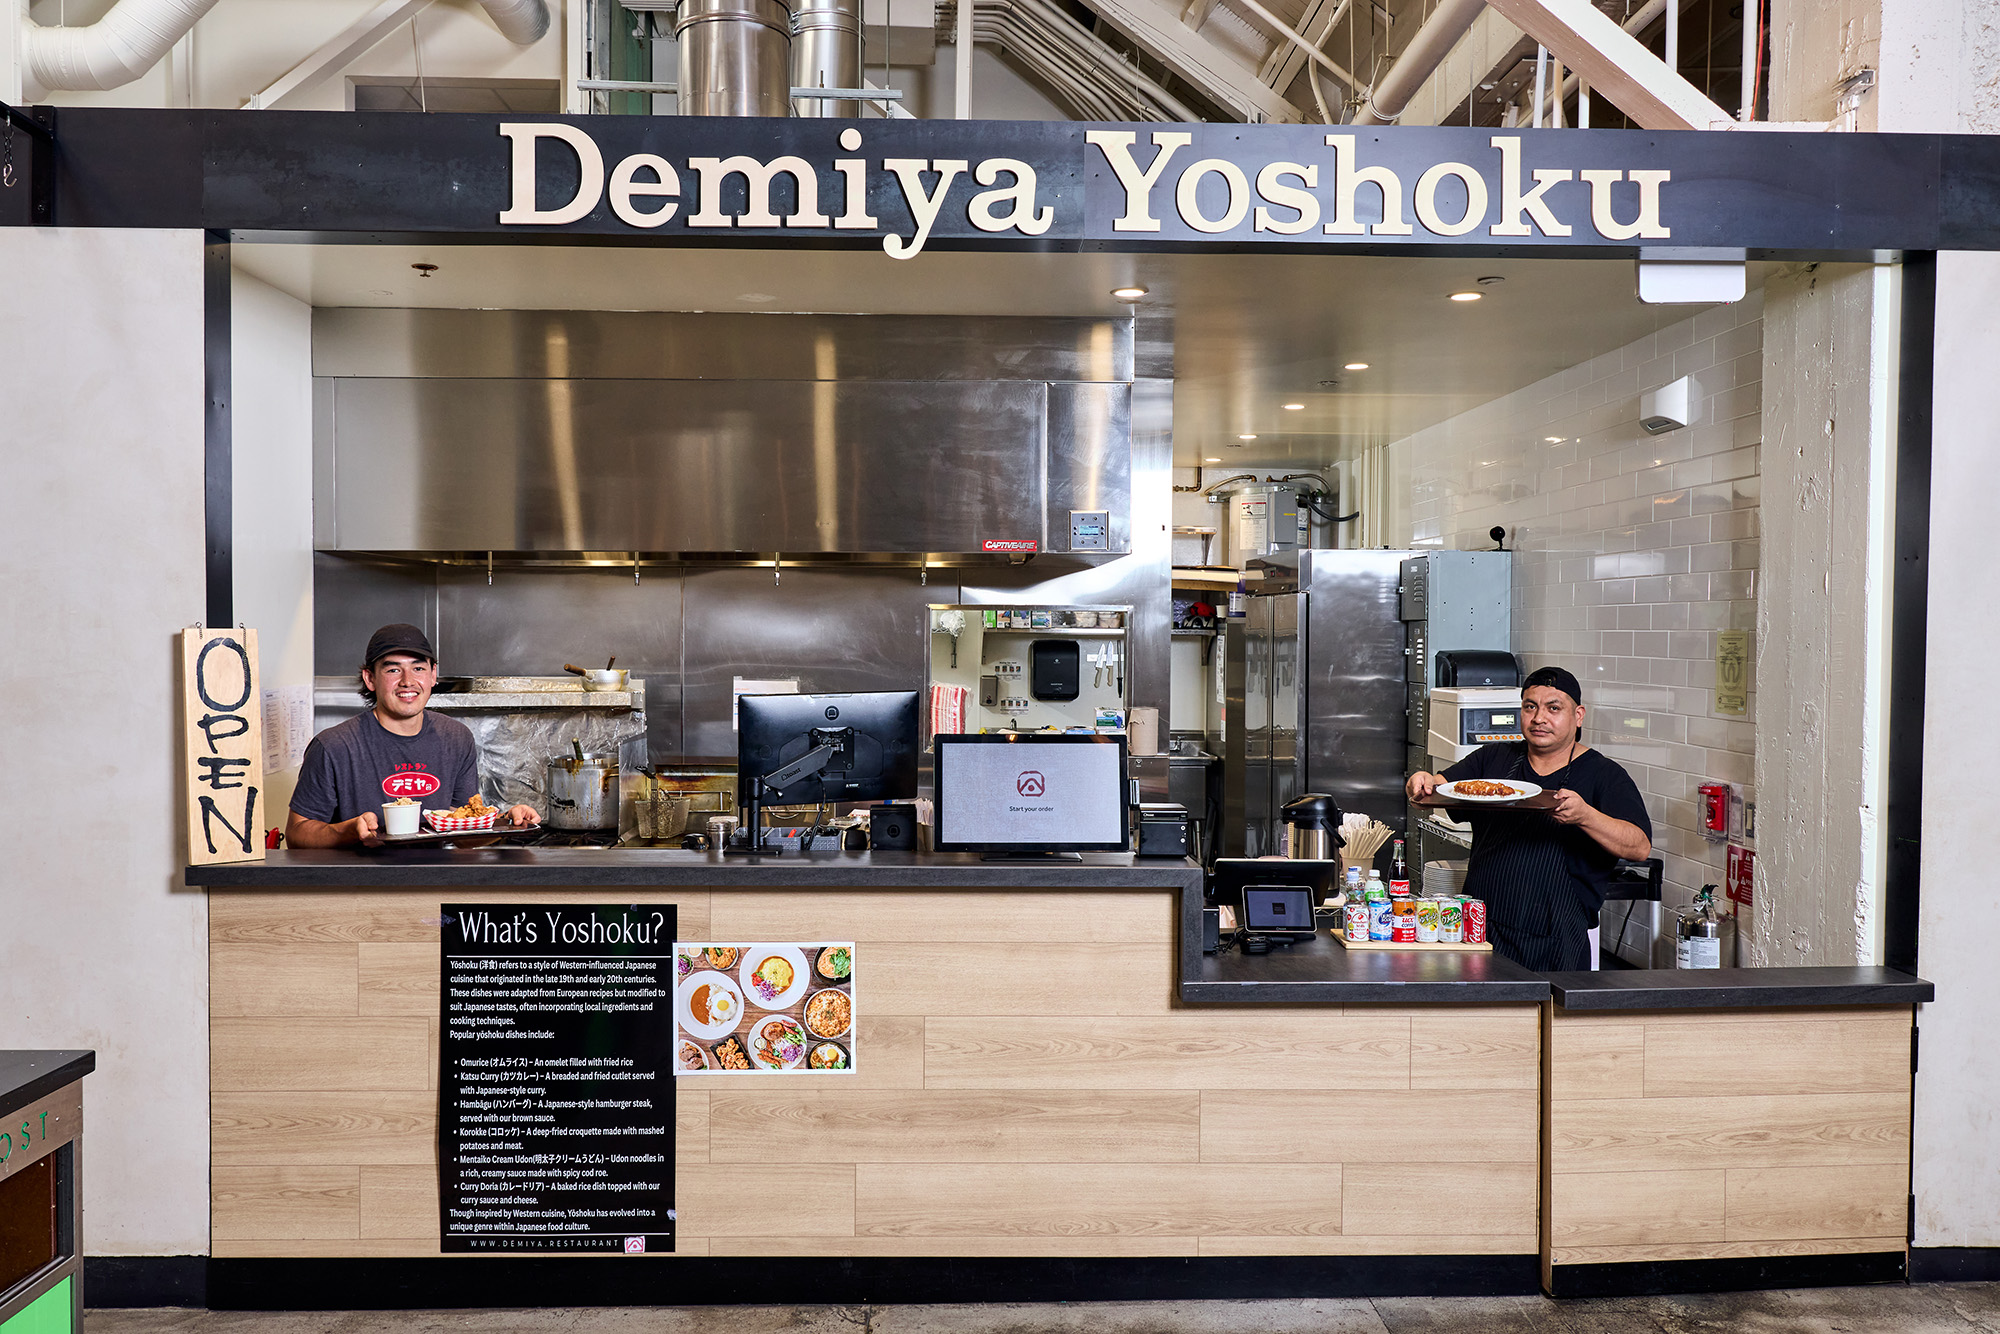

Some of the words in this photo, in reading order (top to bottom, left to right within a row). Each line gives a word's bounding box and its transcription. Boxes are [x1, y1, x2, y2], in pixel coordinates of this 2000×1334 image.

[498, 122, 1054, 260] Demiya
[1085, 130, 1671, 239] Yoshoku
[196, 637, 258, 855] OPEN
[394, 762, 427, 772] レストラン
[392, 778, 426, 792] デミヤ
[545, 912, 664, 944] Yoshoku?
[1469, 902, 1484, 943] Coca-Cola
[499, 960, 519, 969] refers
[534, 960, 550, 971] style
[551, 960, 558, 969] of
[559, 960, 624, 969] Western-influenced
[625, 960, 656, 971] Japanese
[450, 974, 474, 983] cuisine
[474, 974, 489, 983] that
[490, 974, 524, 985] originated
[525, 974, 532, 983] in
[532, 974, 544, 983] the
[545, 974, 558, 983] late
[559, 974, 574, 983] 19th
[575, 974, 588, 983] and
[589, 974, 606, 985] early
[607, 974, 623, 983] 20th
[624, 974, 656, 983] centuries.
[450, 988, 470, 997] These
[470, 988, 492, 997] dishes
[510, 988, 538, 999] adapted
[539, 988, 556, 997] from
[557, 988, 588, 999] European
[589, 988, 614, 999] recipes
[614, 988, 626, 997] but
[627, 988, 657, 997] modified
[450, 1002, 462, 1011] suit
[464, 1003, 495, 1013] Japanese
[496, 1003, 518, 1012] tastes,
[519, 1002, 538, 1011] often
[538, 1002, 584, 1013] incorporating
[584, 1002, 601, 1011] local
[602, 1002, 639, 1013] ingredients
[640, 1002, 653, 1011] and
[450, 1016, 476, 1027] cooking
[476, 1016, 515, 1027] techniques.
[450, 1030, 475, 1040] Popular
[505, 1030, 527, 1039] dishes
[528, 1030, 554, 1039] include:
[460, 1058, 489, 1067] Omurice
[534, 1058, 544, 1066] An
[544, 1058, 568, 1066] omelet
[569, 1057, 586, 1066] filled
[588, 1057, 602, 1066] with
[603, 1057, 620, 1066] fried
[620, 1057, 634, 1066] rice
[460, 1072, 479, 1080] Katsu
[480, 1072, 499, 1083] Curry
[545, 1072, 550, 1080] A
[552, 1072, 579, 1080] breaded
[580, 1071, 593, 1080] and
[594, 1071, 610, 1080] fried
[611, 1071, 631, 1080] cutlet
[632, 1071, 654, 1080] served
[460, 1086, 475, 1094] with
[476, 1086, 526, 1096] Japanese-style
[527, 1087, 546, 1096] curry.
[538, 1100, 543, 1108] A
[544, 1099, 594, 1110] Japanese-style
[596, 1099, 632, 1110] hamburger
[632, 1099, 652, 1109] steak,
[460, 1114, 482, 1122] served
[484, 1113, 498, 1122] with
[512, 1113, 533, 1122] brown
[460, 1127, 487, 1136] Korokke
[526, 1127, 532, 1136] A
[532, 1127, 568, 1138] deep-fried
[568, 1128, 602, 1137] croquette
[602, 1126, 622, 1135] made
[622, 1126, 637, 1135] with
[638, 1126, 664, 1135] mashed
[460, 1142, 490, 1152] potatoes
[490, 1141, 504, 1150] and
[460, 1155, 491, 1164] Mentaiko
[492, 1155, 514, 1164] Cream
[610, 1154, 629, 1163] Udon
[630, 1154, 656, 1162] noodles
[658, 1153, 664, 1162] in
[466, 1169, 480, 1178] rich,
[481, 1170, 506, 1179] creamy
[528, 1168, 546, 1177] made
[547, 1168, 562, 1177] with
[563, 1168, 580, 1179] spicy
[581, 1168, 594, 1177] cod
[460, 1182, 479, 1193] Curry
[480, 1182, 498, 1191] Doria
[550, 1182, 556, 1190] A
[557, 1182, 577, 1190] baked
[578, 1182, 591, 1190] rice
[592, 1182, 606, 1190] dish
[607, 1182, 632, 1192] topped
[632, 1181, 647, 1190] with
[460, 1197, 478, 1206] curry
[500, 1196, 512, 1204] and
[513, 1195, 538, 1204] cheese.
[450, 1209, 474, 1219] Though
[476, 1209, 502, 1219] inspired
[503, 1209, 512, 1219] by
[512, 1209, 540, 1217] Western
[541, 1209, 566, 1219] cuisine,
[596, 1209, 608, 1217] has
[609, 1208, 636, 1217] evolved
[636, 1208, 650, 1216] into
[450, 1222, 473, 1232] unique
[474, 1223, 493, 1232] genre
[494, 1222, 514, 1230] within
[515, 1223, 546, 1232] Japanese
[548, 1222, 563, 1231] food
[564, 1222, 590, 1231] culture.
[470, 1239, 618, 1248] WWW.DEMIYA.RESTAURANT
